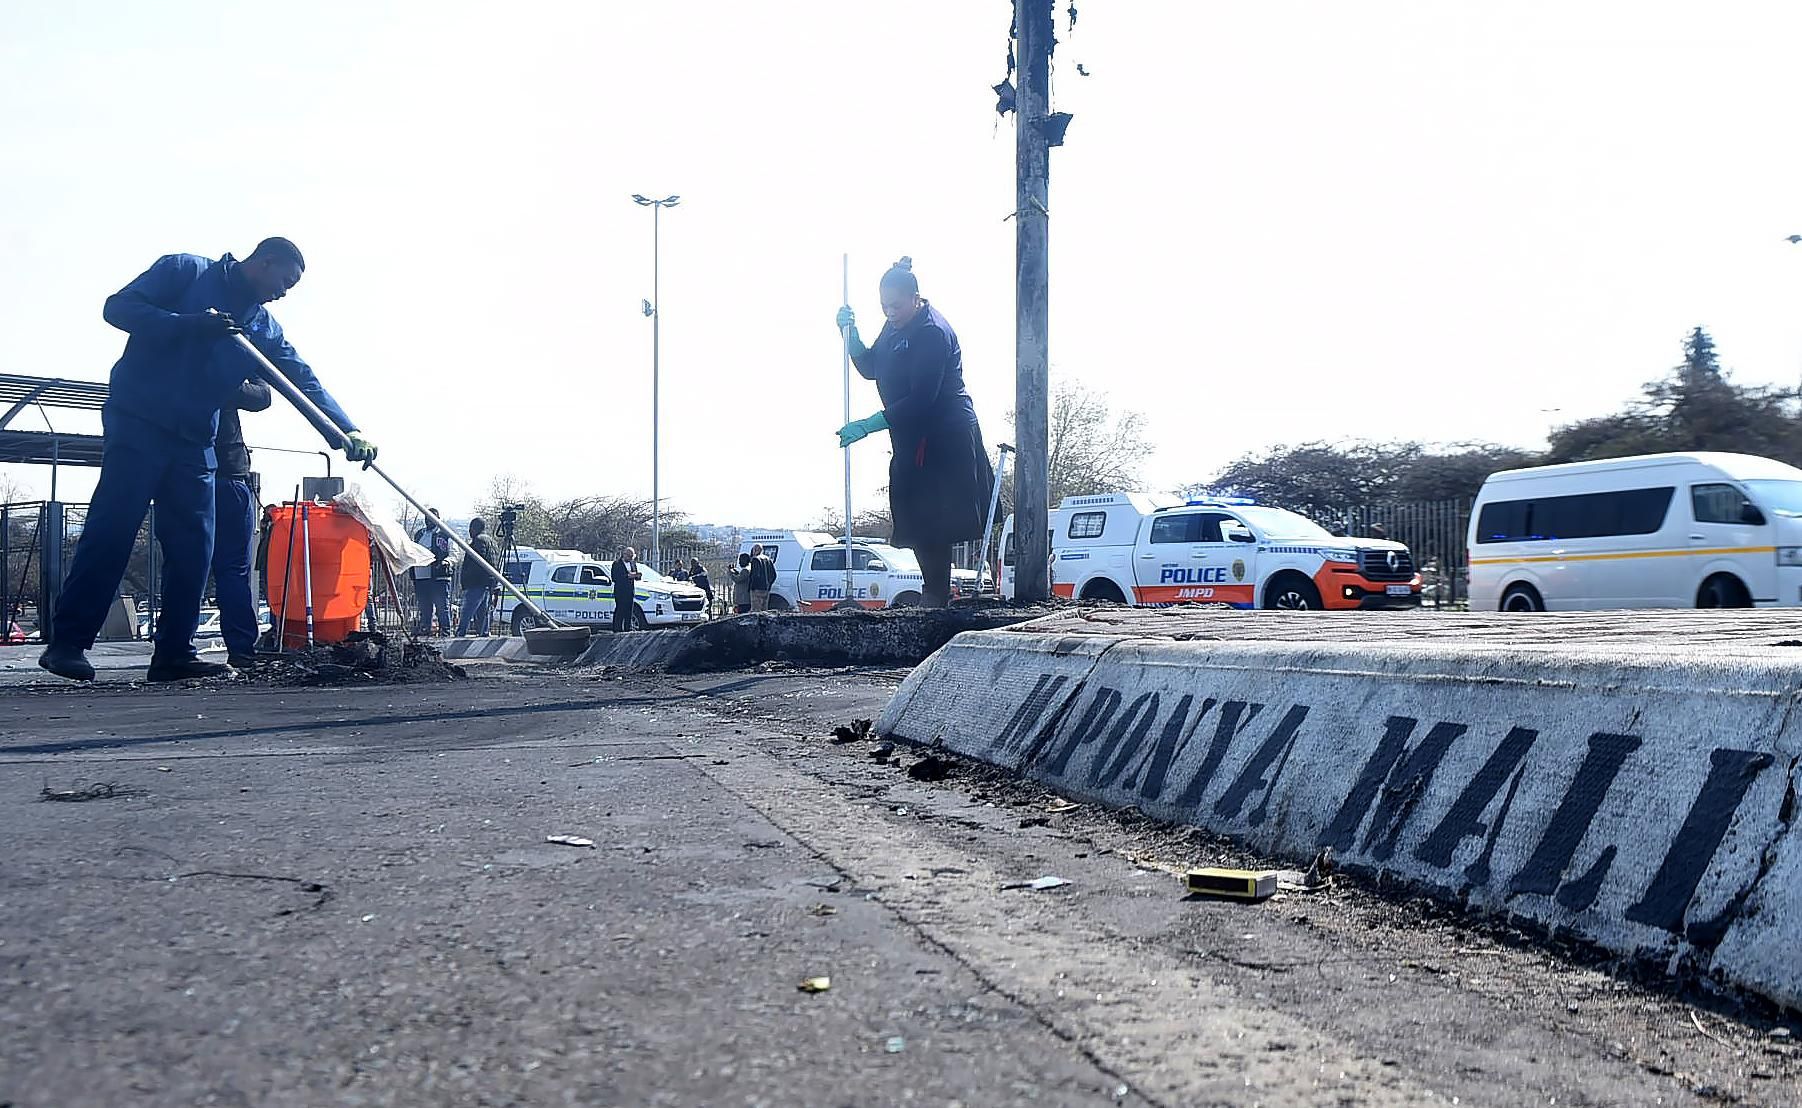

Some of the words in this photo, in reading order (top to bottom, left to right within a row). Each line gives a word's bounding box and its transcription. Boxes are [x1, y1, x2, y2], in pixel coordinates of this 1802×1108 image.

[1160, 567, 1227, 584] POLICE
[818, 587, 867, 599] POLCE
[1174, 588, 1215, 598] JMPD
[575, 610, 611, 619] POLICE
[1314, 715, 1776, 953] MALL
